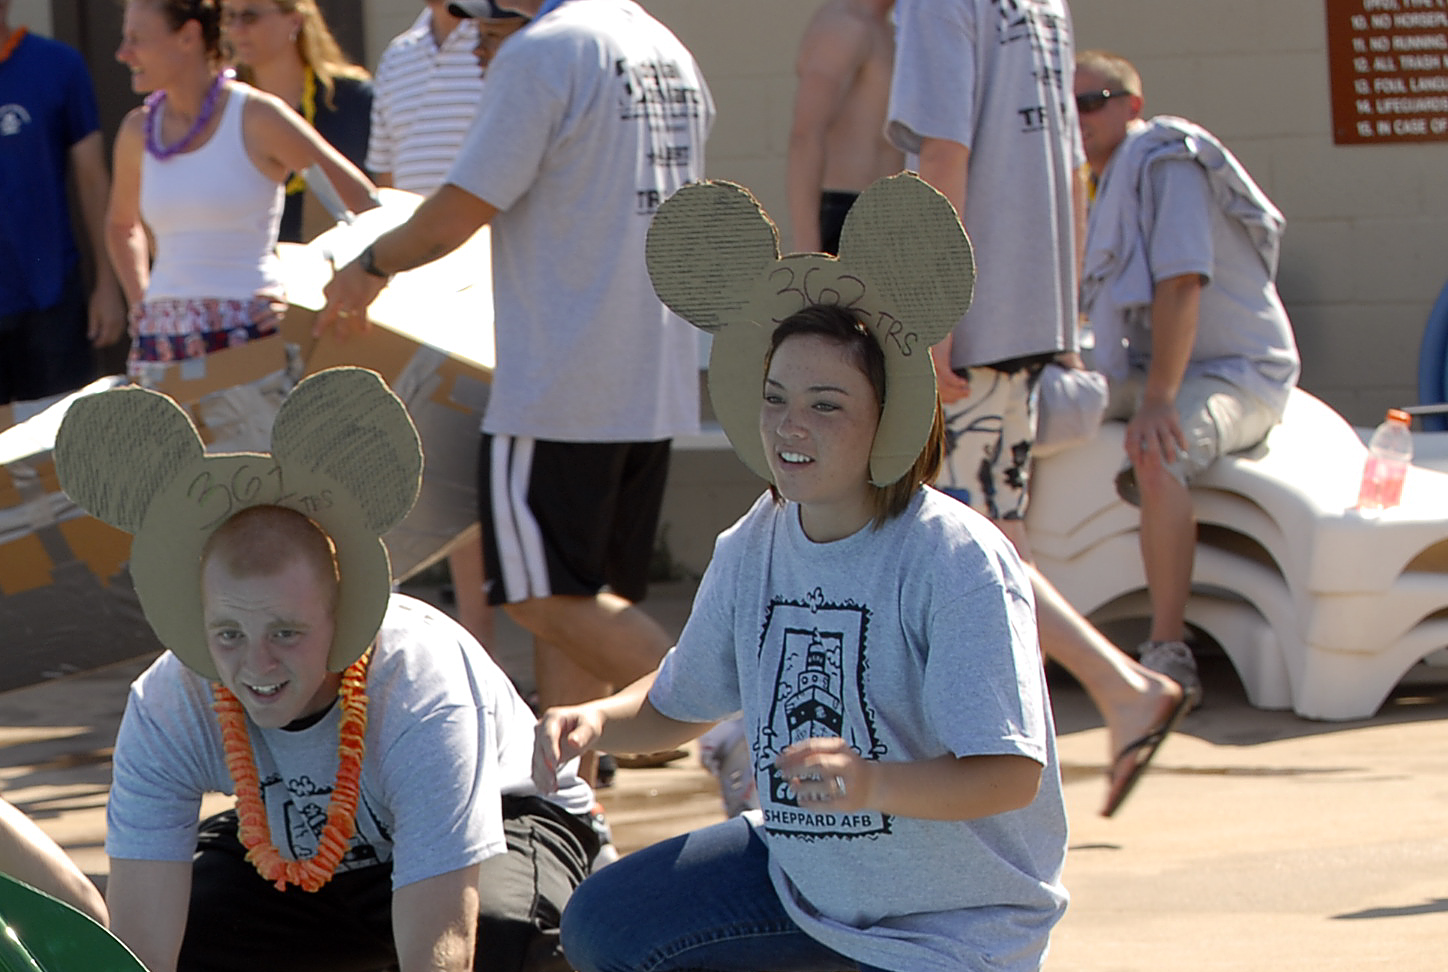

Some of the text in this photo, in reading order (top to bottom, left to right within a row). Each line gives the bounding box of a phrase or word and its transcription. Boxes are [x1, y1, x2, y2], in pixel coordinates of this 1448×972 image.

[1371, 13, 1392, 29] NO
[1369, 36, 1390, 52] NO
[1373, 56, 1397, 72] ALL
[1399, 54, 1441, 70] TRASH
[1373, 77, 1407, 93] FOUL
[1376, 120, 1392, 136] IN
[1393, 118, 1428, 134] CASE
[876, 311, 918, 357] TRS
[764, 809, 872, 828] SHEPPARD AFB
